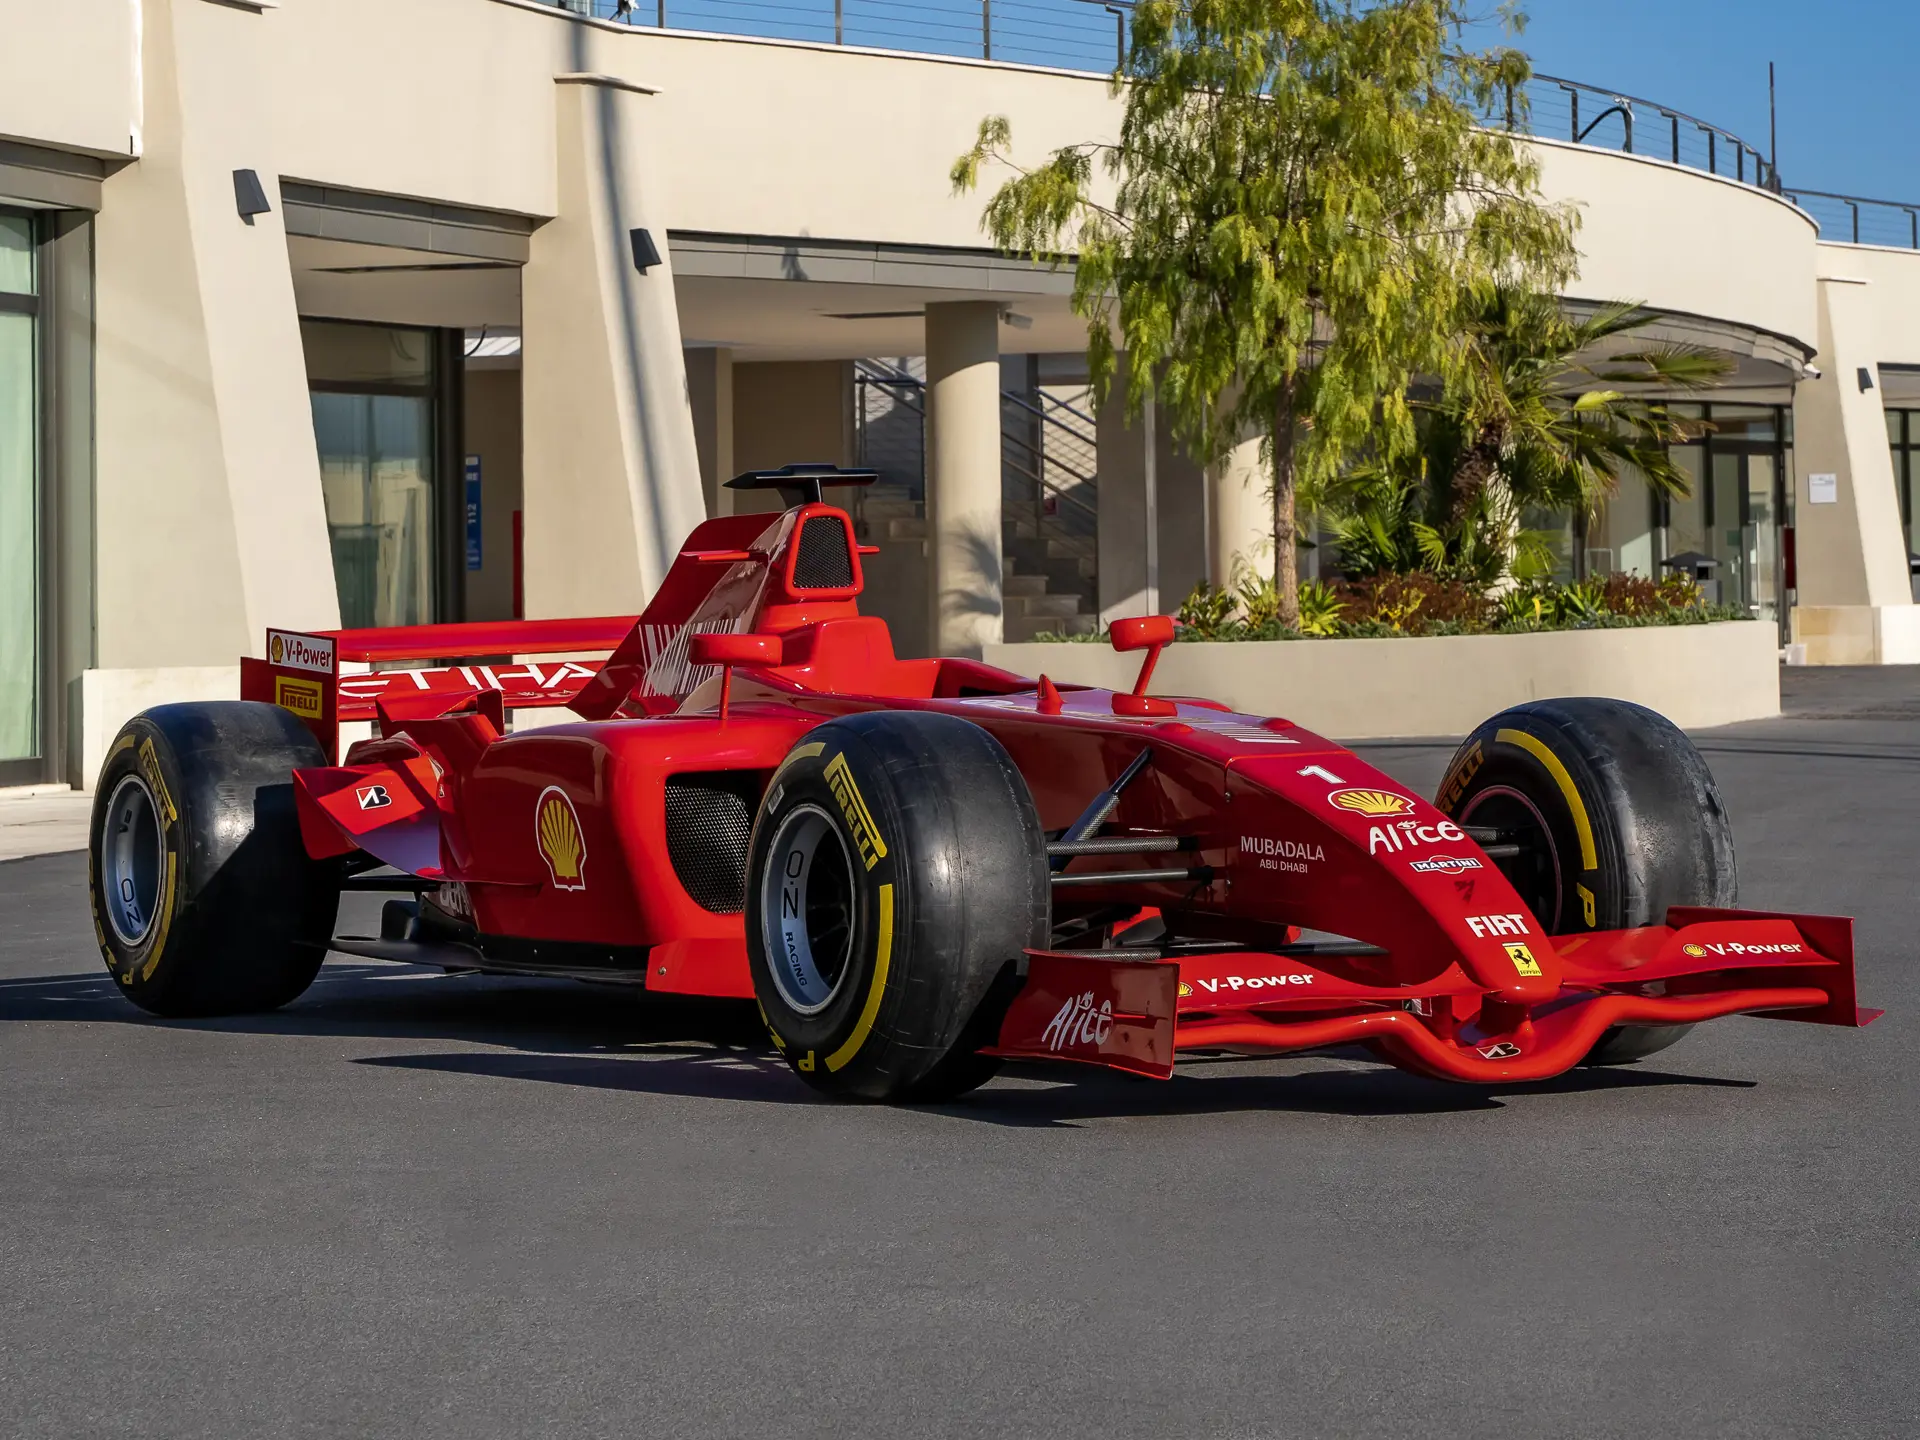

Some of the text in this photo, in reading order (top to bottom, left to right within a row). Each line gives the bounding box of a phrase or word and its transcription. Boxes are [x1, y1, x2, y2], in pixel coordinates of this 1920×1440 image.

[284, 639, 331, 667] V-Power
[280, 683, 318, 711] PIRELLI
[1296, 765, 1347, 784] 1
[823, 751, 888, 872] PIRELLI
[1241, 835, 1326, 862] MUBADALA
[1369, 820, 1465, 856] Alice
[1260, 858, 1308, 874] ABU DHABI
[1416, 860, 1478, 870] MARTINI
[1464, 913, 1530, 938] FIAT
[785, 931, 808, 987] RACING
[1705, 942, 1803, 956] V-Power
[1196, 973, 1314, 993] V-Power
[1041, 990, 1112, 1051] Alice
